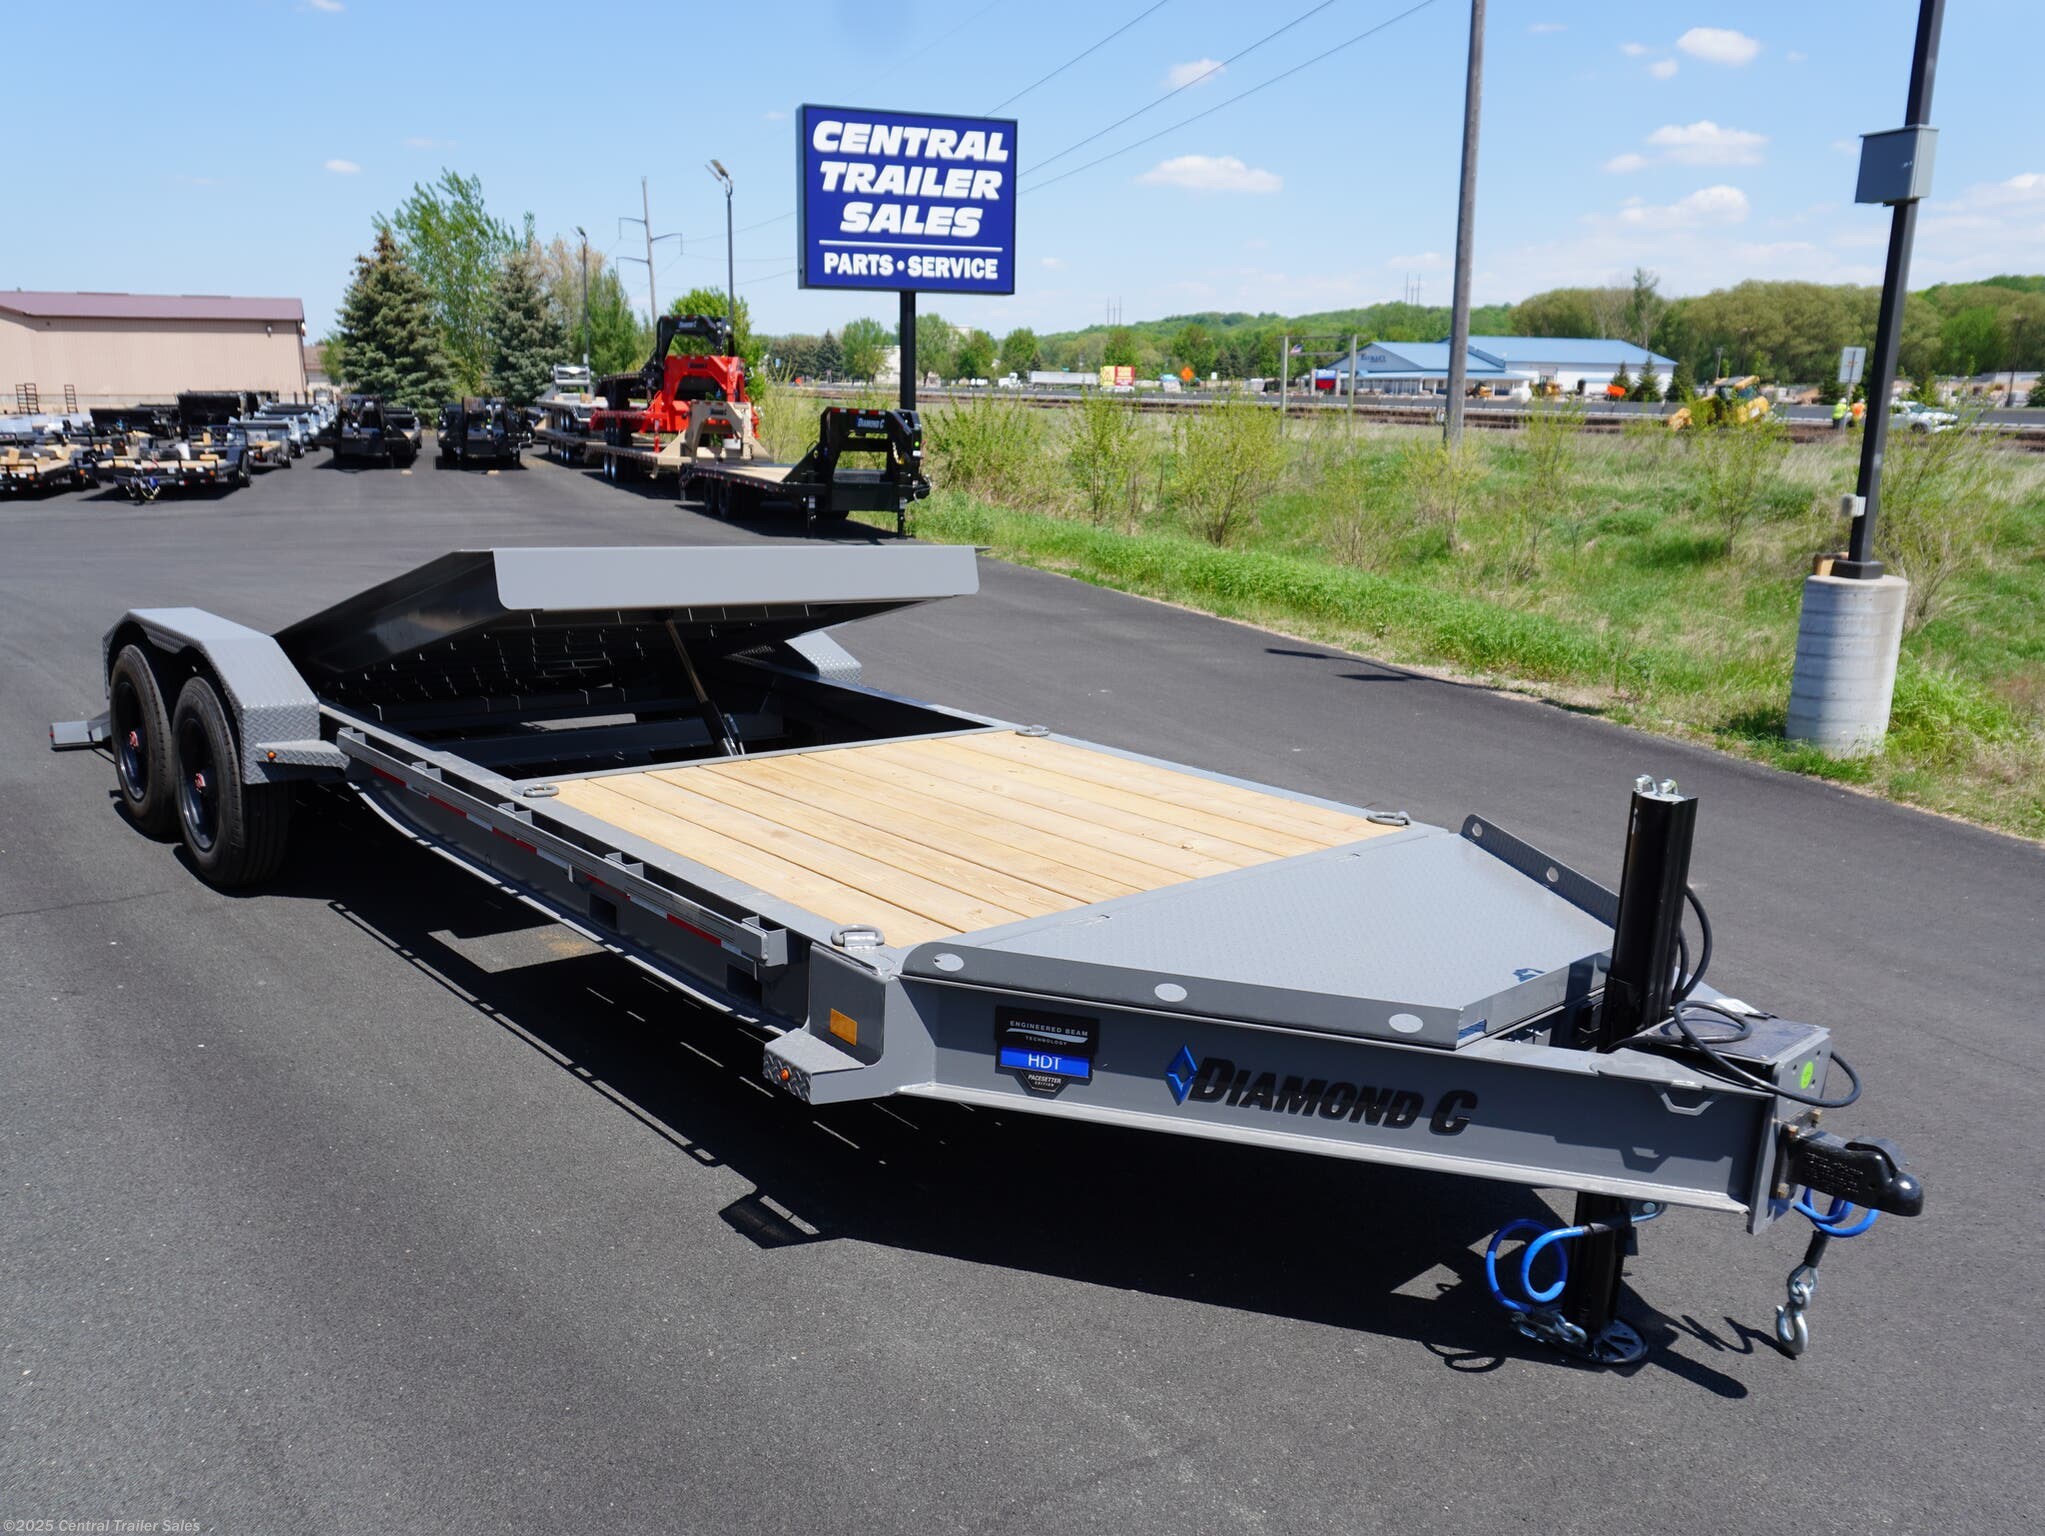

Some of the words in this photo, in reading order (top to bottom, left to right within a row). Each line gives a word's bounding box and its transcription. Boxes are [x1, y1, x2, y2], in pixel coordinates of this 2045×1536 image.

[813, 120, 1008, 162] CENTRAL
[820, 161, 1003, 200] TRAILER
[840, 201, 983, 238] SALES
[824, 252, 894, 276] PARTS
[907, 255, 998, 280] SERVICE
[1010, 1020, 1062, 1033] ENGINEERED
[1065, 1028, 1089, 1037] BEAM
[1028, 1053, 1062, 1070] HDT
[1187, 1057, 1424, 1129] DIAMOND
[1429, 1089, 1478, 1136] C
